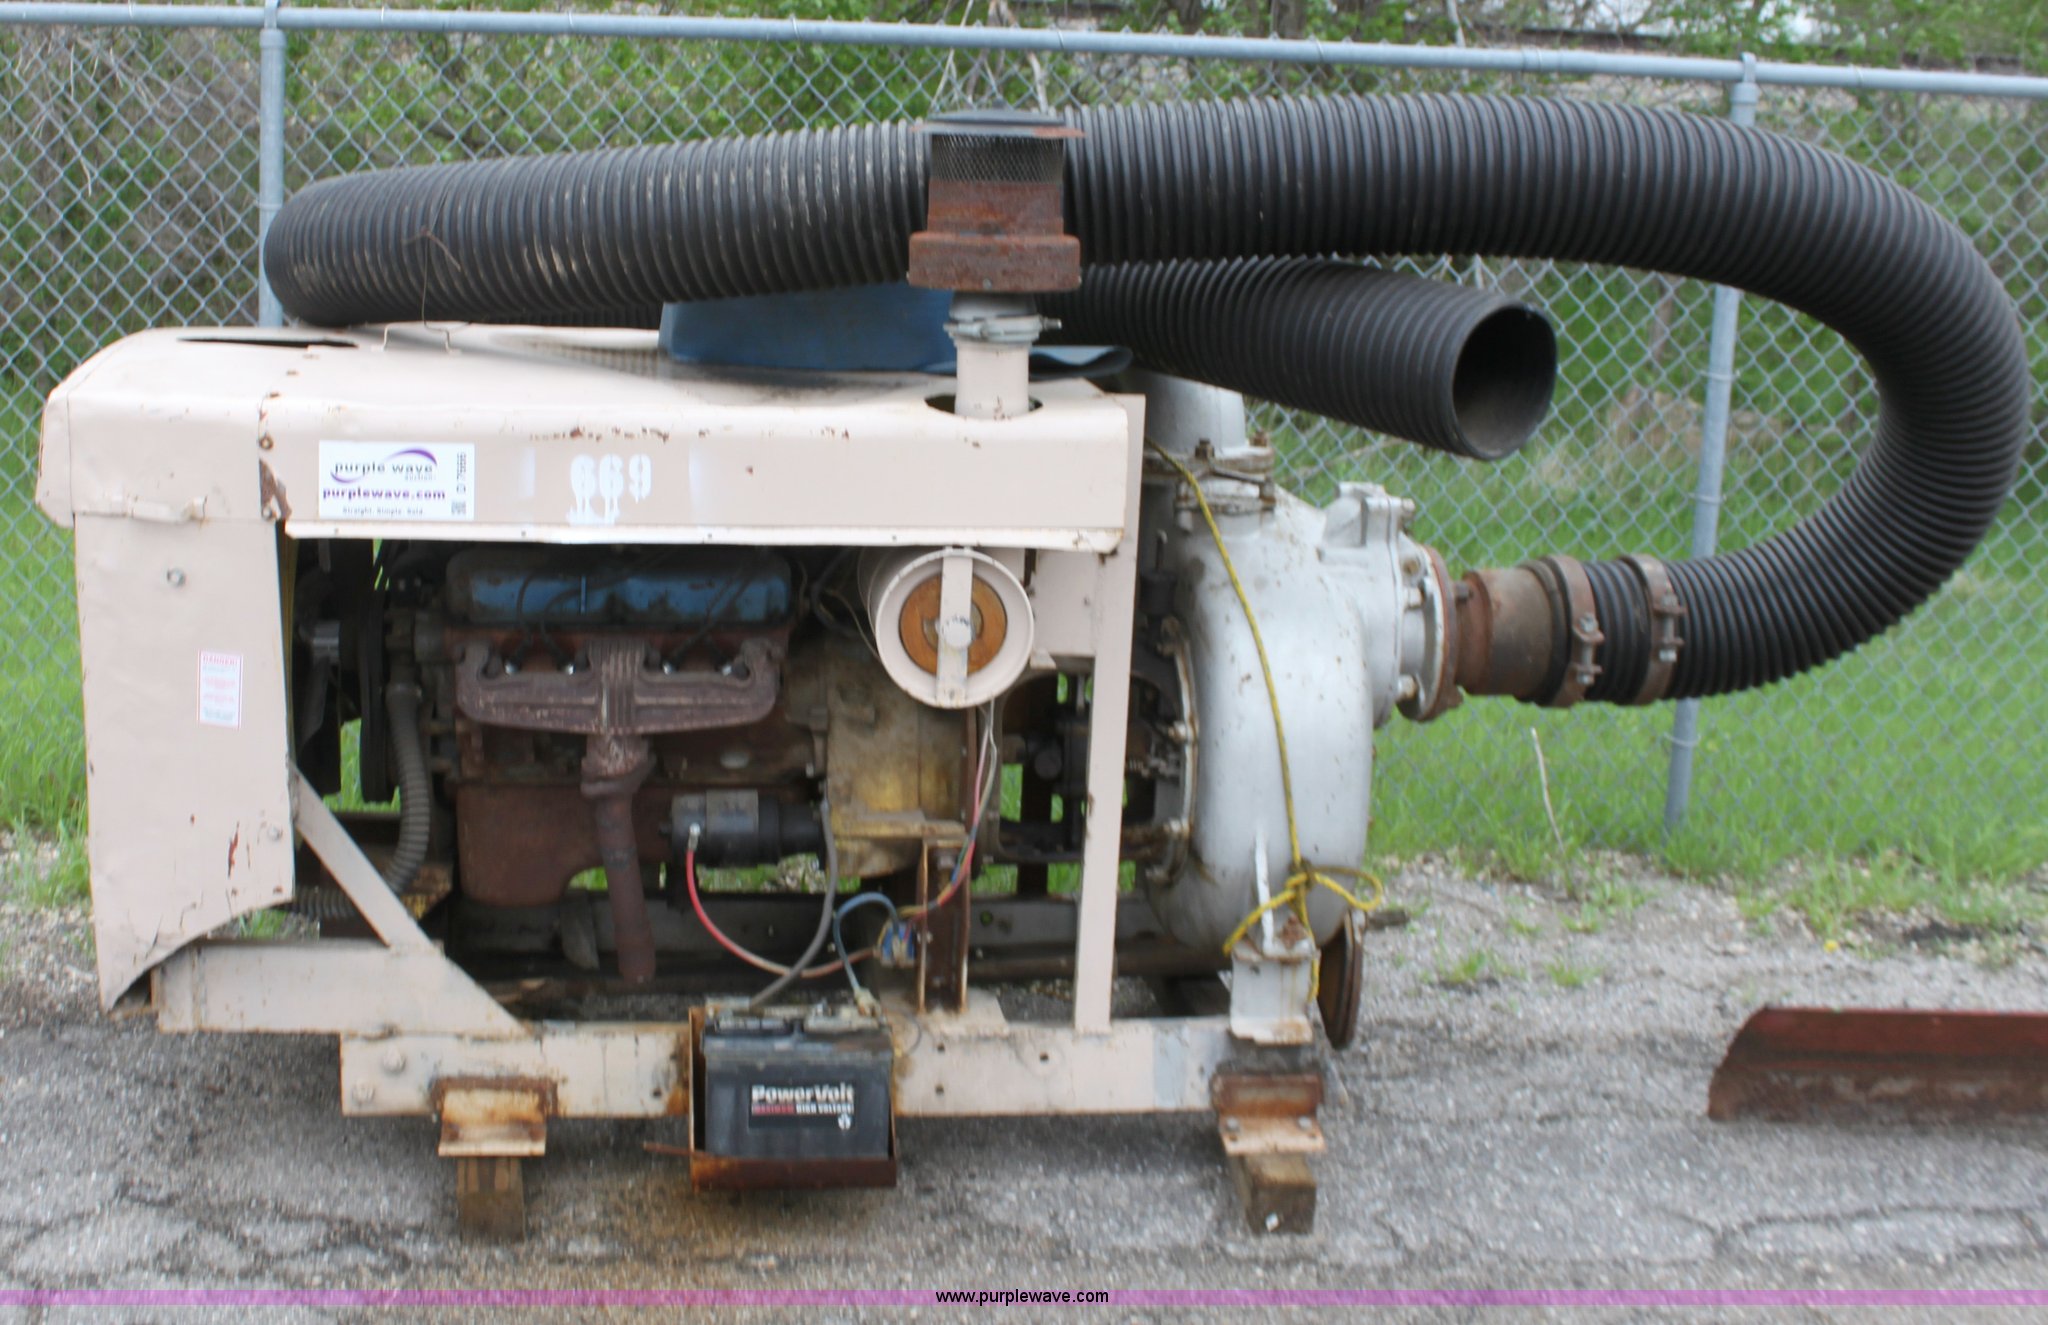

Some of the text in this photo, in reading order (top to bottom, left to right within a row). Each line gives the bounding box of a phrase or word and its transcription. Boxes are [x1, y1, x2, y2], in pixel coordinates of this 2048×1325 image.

[335, 461, 433, 475] purple wave
[567, 453, 651, 502] 669
[323, 486, 446, 500] purplewave.com
[752, 1083, 854, 1104] PowerVolt
